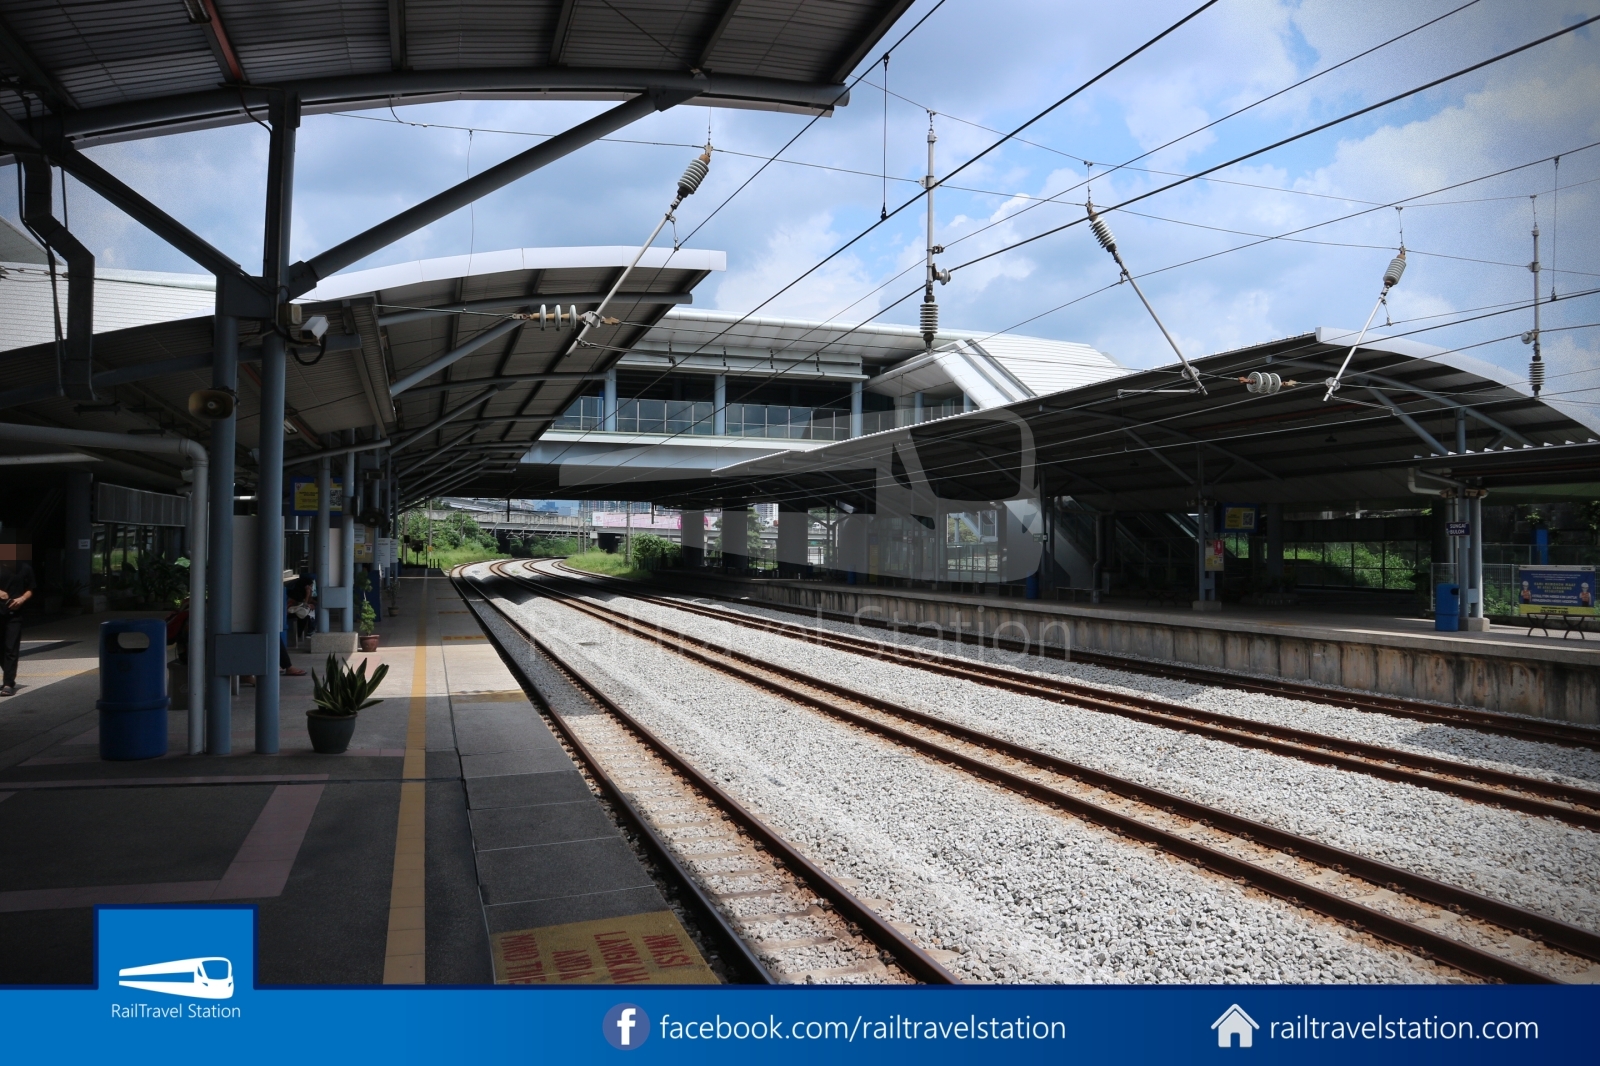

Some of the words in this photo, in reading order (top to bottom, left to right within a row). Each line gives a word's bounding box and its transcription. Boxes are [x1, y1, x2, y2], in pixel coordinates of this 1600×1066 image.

[500, 933, 540, 962] MIND
[593, 930, 650, 984] LANGKAH
[552, 949, 595, 981] ANDA
